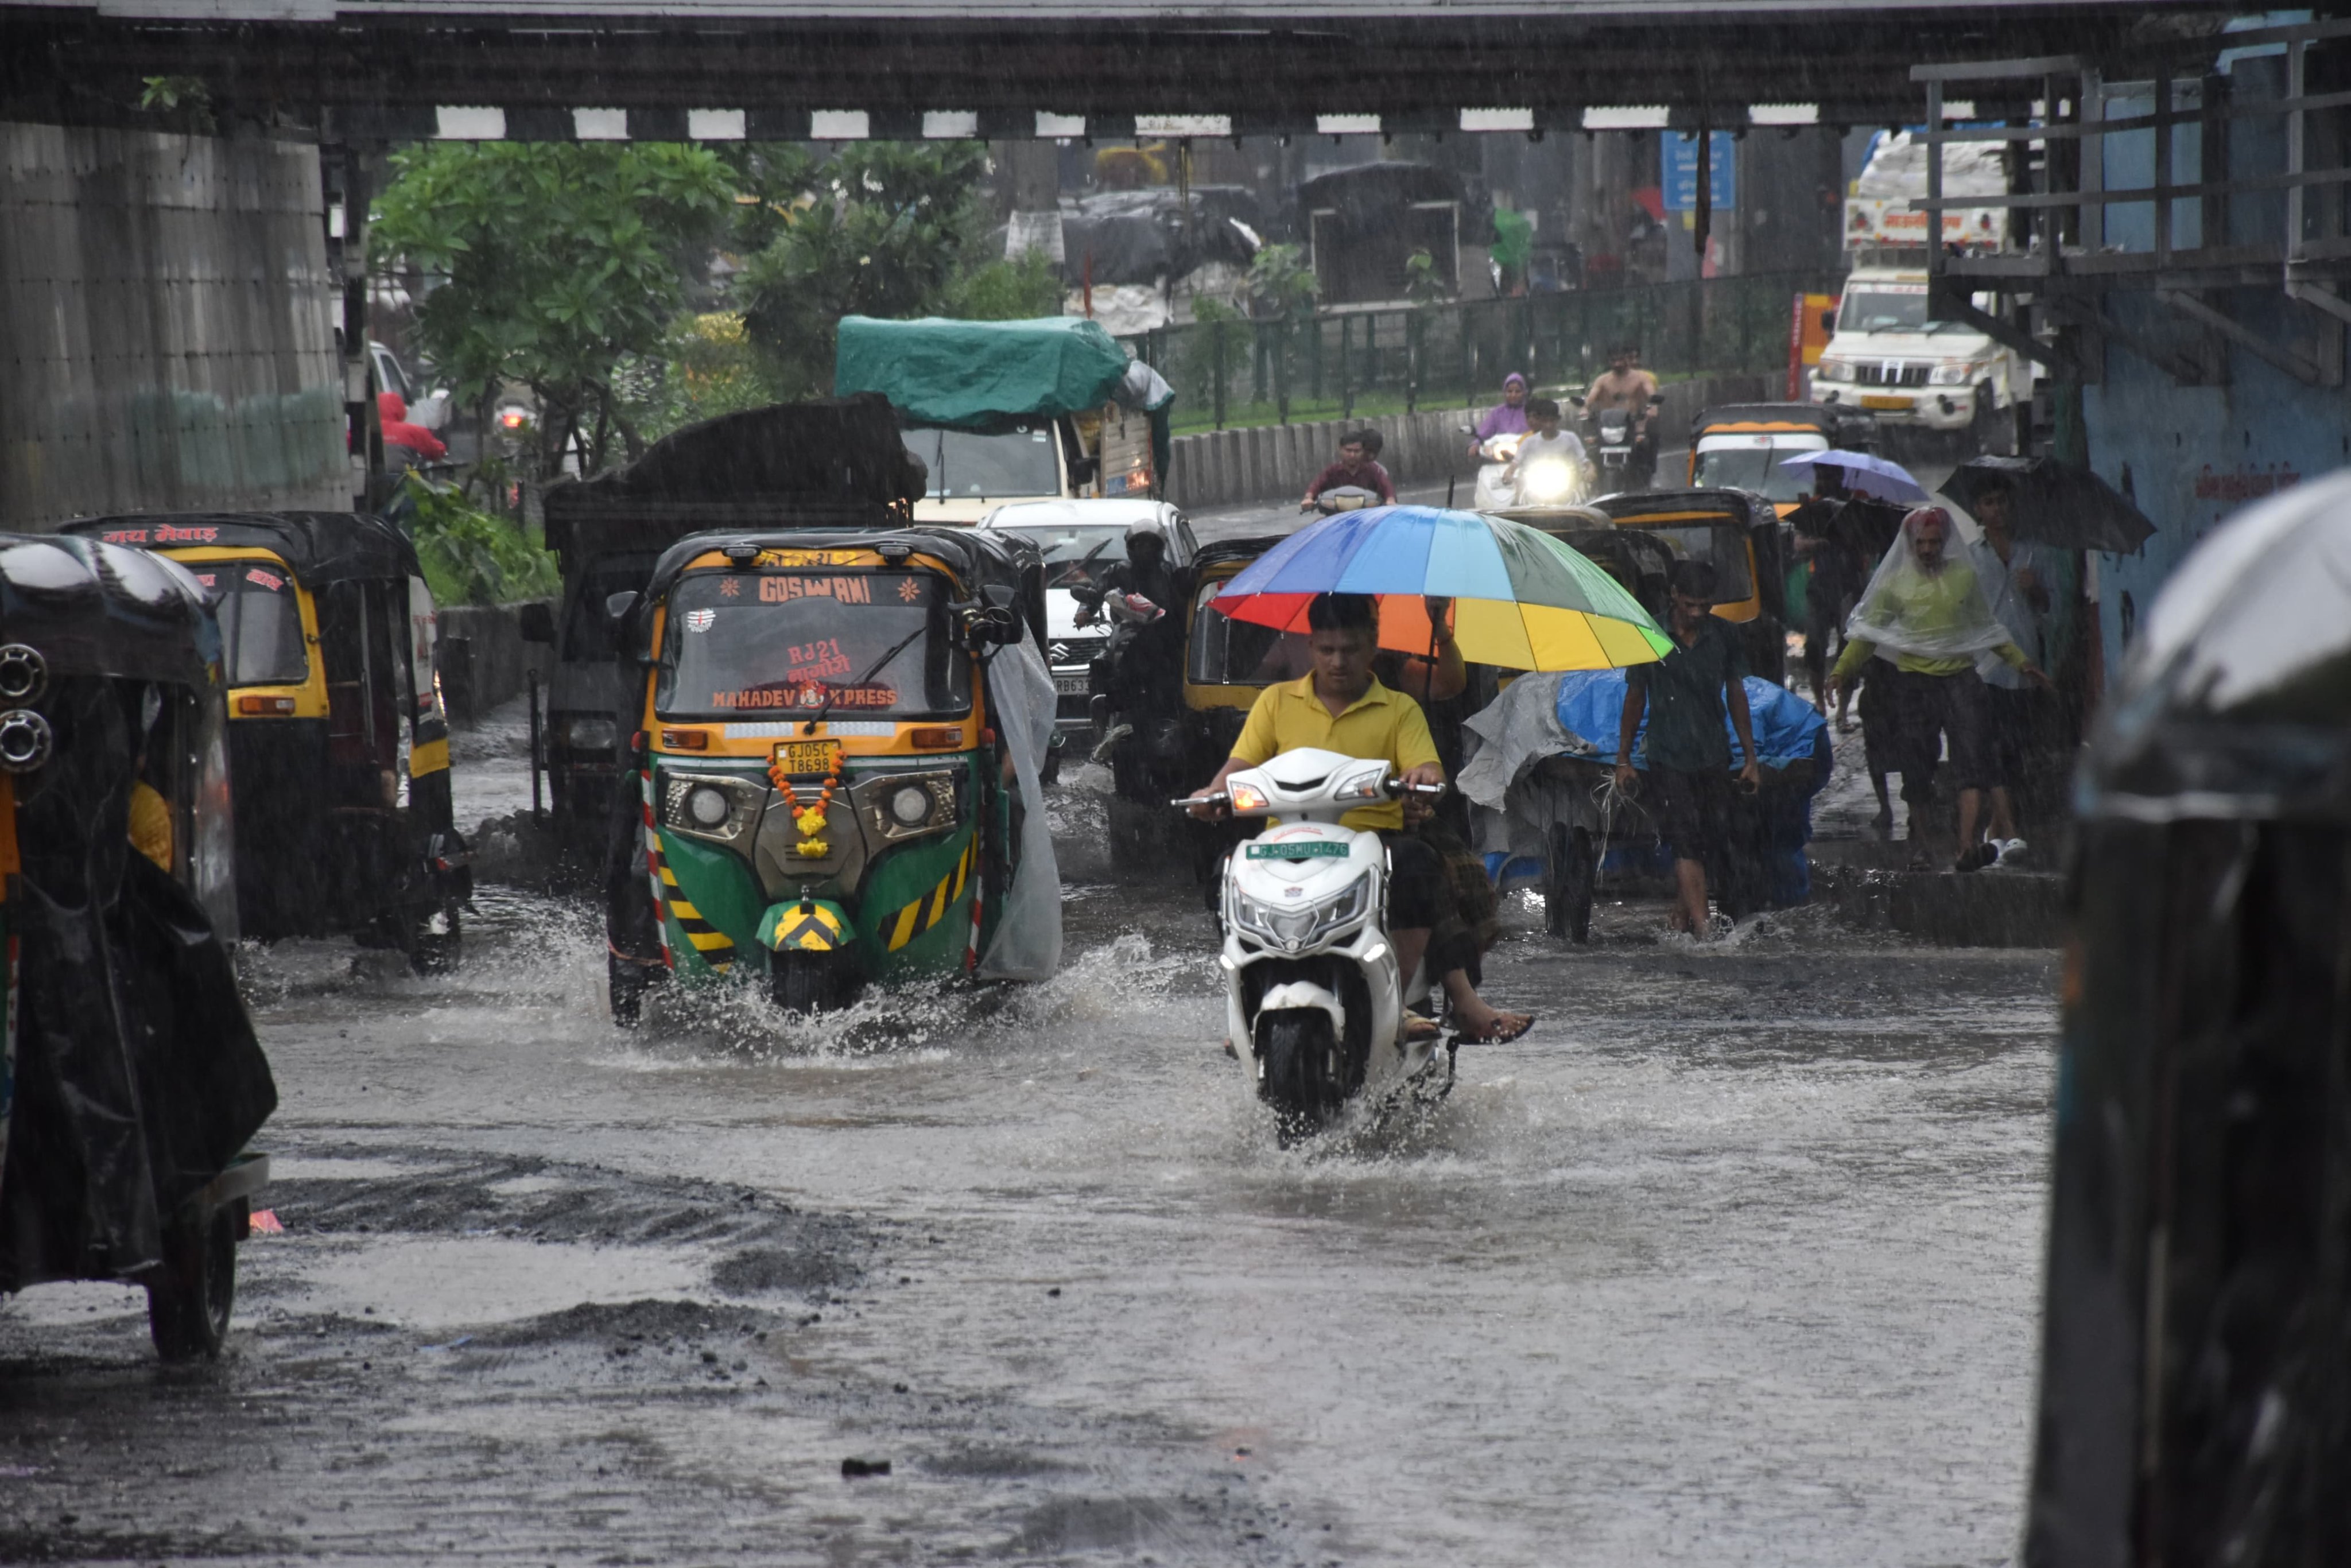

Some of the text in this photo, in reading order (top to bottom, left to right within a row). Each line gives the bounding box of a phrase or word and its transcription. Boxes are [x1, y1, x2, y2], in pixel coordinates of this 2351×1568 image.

[712, 690, 796, 707] MAHADEV
[788, 743, 829, 758] GJ05C
[789, 758, 829, 773] T8698
